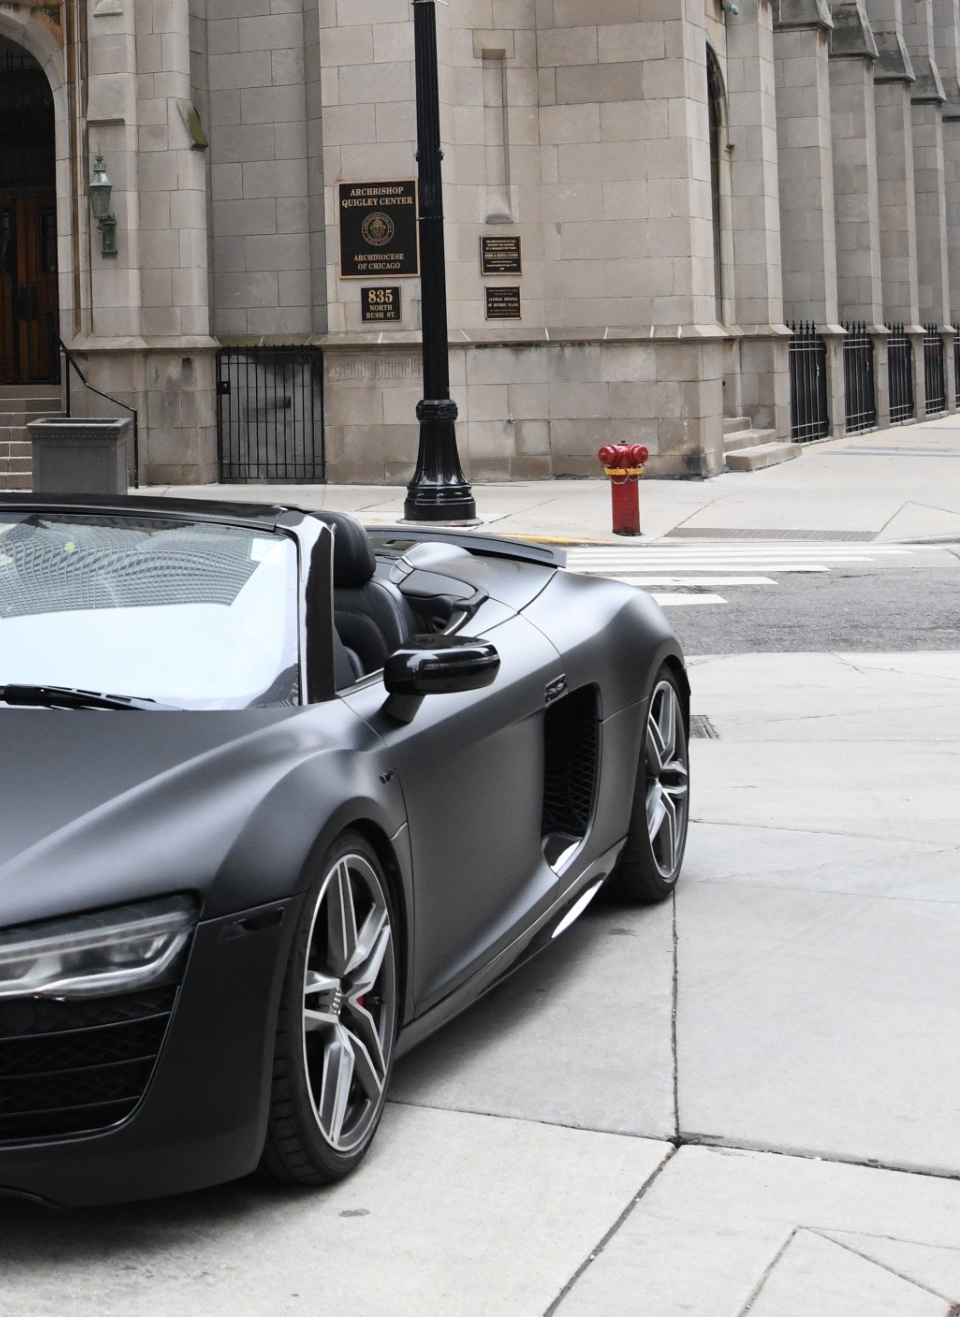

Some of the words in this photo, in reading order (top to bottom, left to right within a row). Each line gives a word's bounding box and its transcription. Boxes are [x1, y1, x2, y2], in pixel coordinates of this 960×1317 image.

[349, 187, 404, 197] ARCHBISHOP
[341, 198, 379, 208] QUIGLEY
[379, 196, 413, 206] CENTER
[353, 253, 405, 262] ARCHDIOCESE
[368, 262, 401, 270] CHICAGO
[368, 289, 393, 304] 835
[369, 304, 393, 312] NORTH
